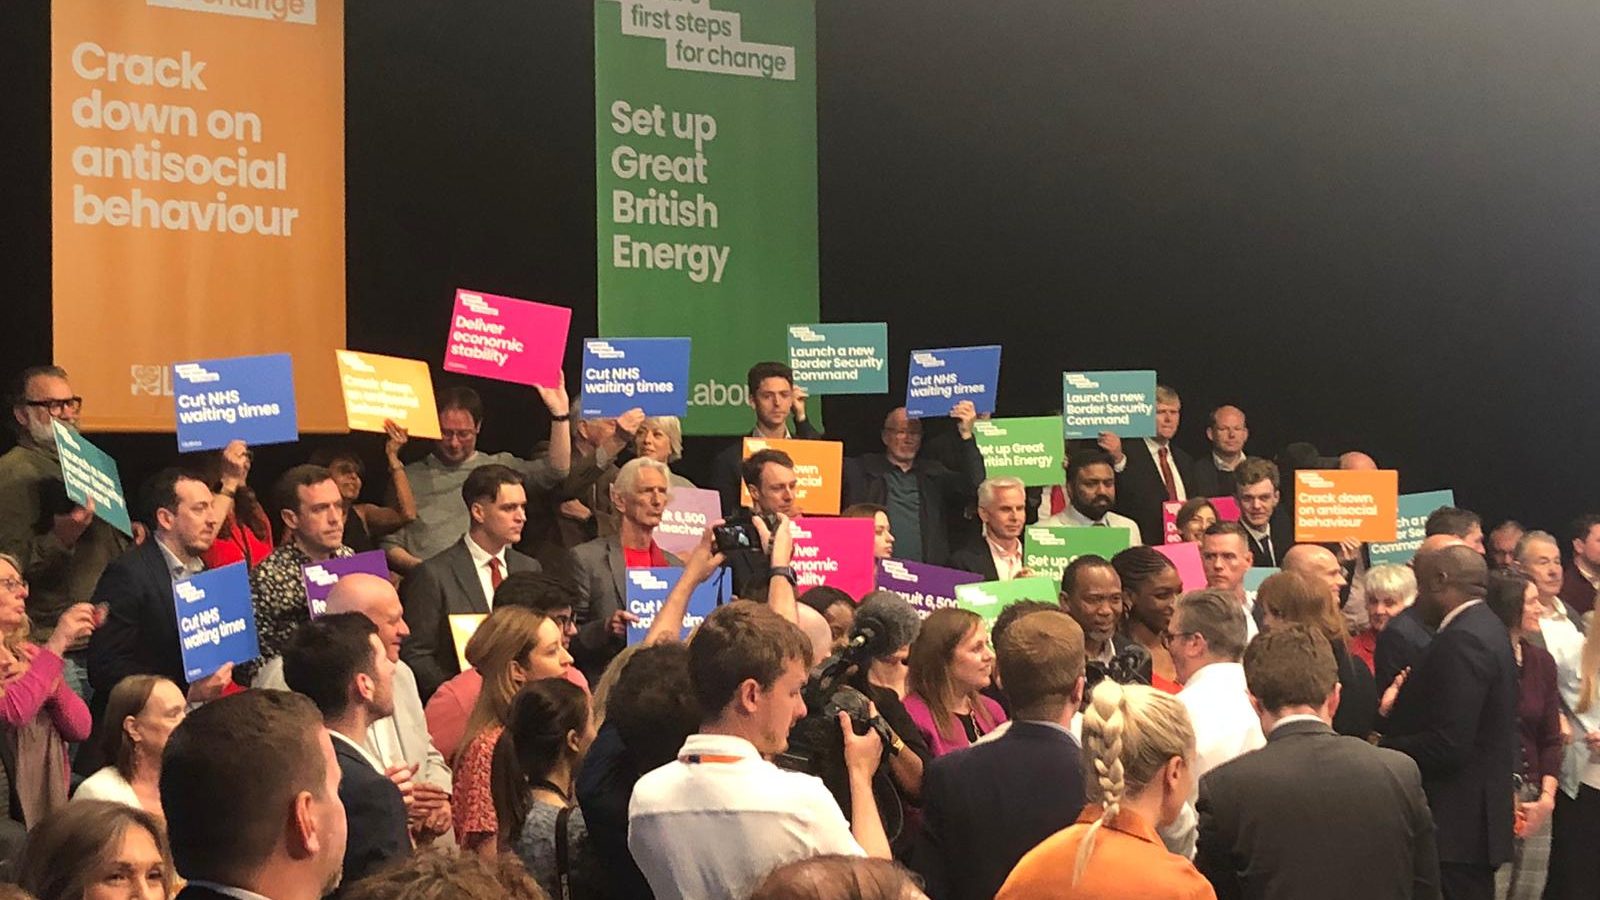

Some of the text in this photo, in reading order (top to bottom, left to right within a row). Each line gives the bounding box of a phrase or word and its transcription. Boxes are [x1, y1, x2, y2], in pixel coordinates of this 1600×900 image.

[631, 4, 732, 41] first steps
[72, 42, 207, 90] Crack
[675, 39, 786, 78] for change
[72, 89, 261, 142] down on
[611, 100, 717, 150] Set up
[72, 140, 286, 190] antisocial
[611, 145, 708, 184] Great
[73, 184, 298, 236] behaviour
[612, 188, 718, 228] British
[613, 234, 730, 283] Energy
[455, 315, 505, 334] Deliver
[453, 331, 524, 352] economic
[451, 344, 508, 367] stability
[791, 345, 876, 357] Launch a new
[791, 356, 884, 371] Border Security
[586, 368, 640, 380] Cut NHS
[792, 369, 859, 381] Command
[911, 373, 958, 386] Cut NHS
[585, 379, 674, 397] waiting times
[910, 383, 985, 399] waiting times
[178, 390, 240, 409] Cut NHS
[1066, 392, 1146, 403] Launch a new
[180, 403, 280, 425] waiting times
[1066, 401, 1153, 416] Border Security
[1066, 414, 1130, 425] Command
[995, 445, 1011, 459] up
[1012, 442, 1045, 454] Great
[793, 464, 819, 475] own
[984, 455, 1053, 469] ritish Energy
[1298, 491, 1374, 503] Crack down
[1298, 503, 1377, 516] on antisocial
[1298, 516, 1363, 528] behaviour
[1027, 555, 1049, 567] Set
[1050, 556, 1068, 570] up
[630, 600, 656, 614] Cut
[181, 607, 220, 632] Cut NHS
[183, 618, 247, 650] waiting times
